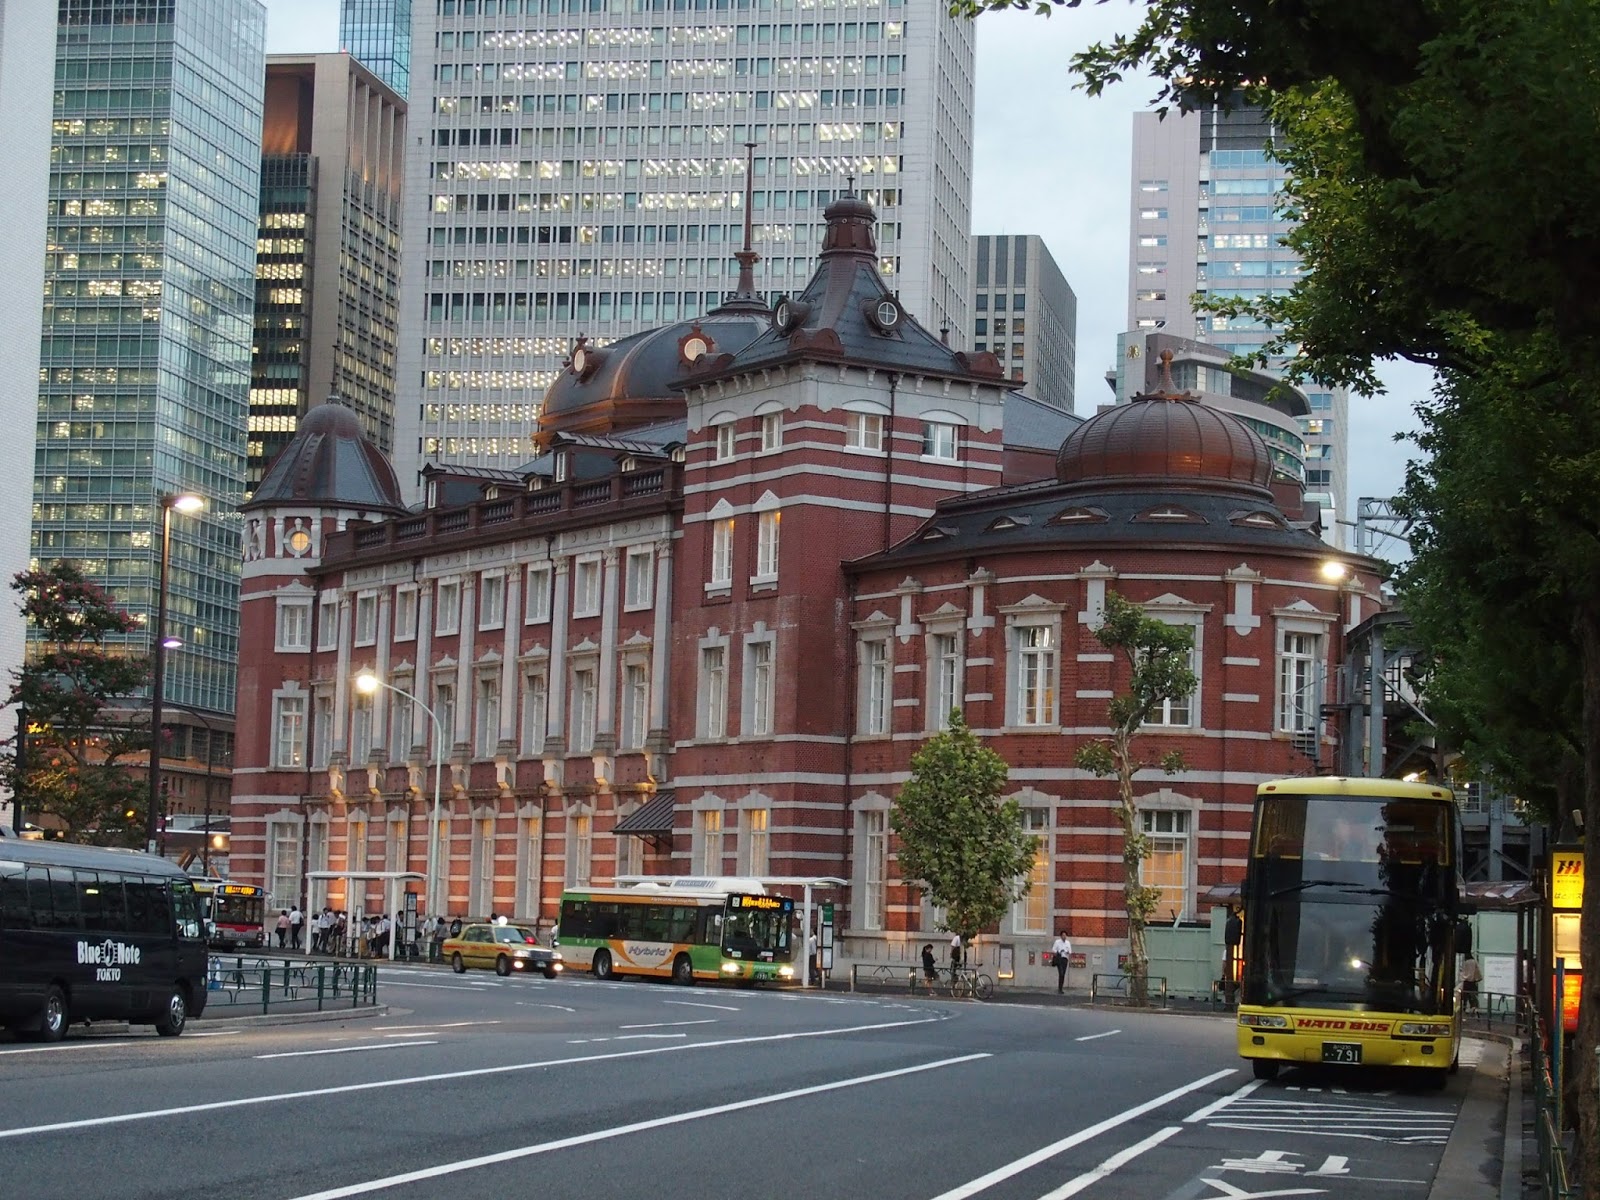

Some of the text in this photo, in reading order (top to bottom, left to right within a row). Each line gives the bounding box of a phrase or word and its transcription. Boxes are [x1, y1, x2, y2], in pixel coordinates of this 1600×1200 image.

[77, 941, 141, 964] Blue Note
[629, 946, 668, 956] Hybrid
[96, 968, 121, 981] TOKYO
[1297, 1018, 1390, 1032] HATO BUS
